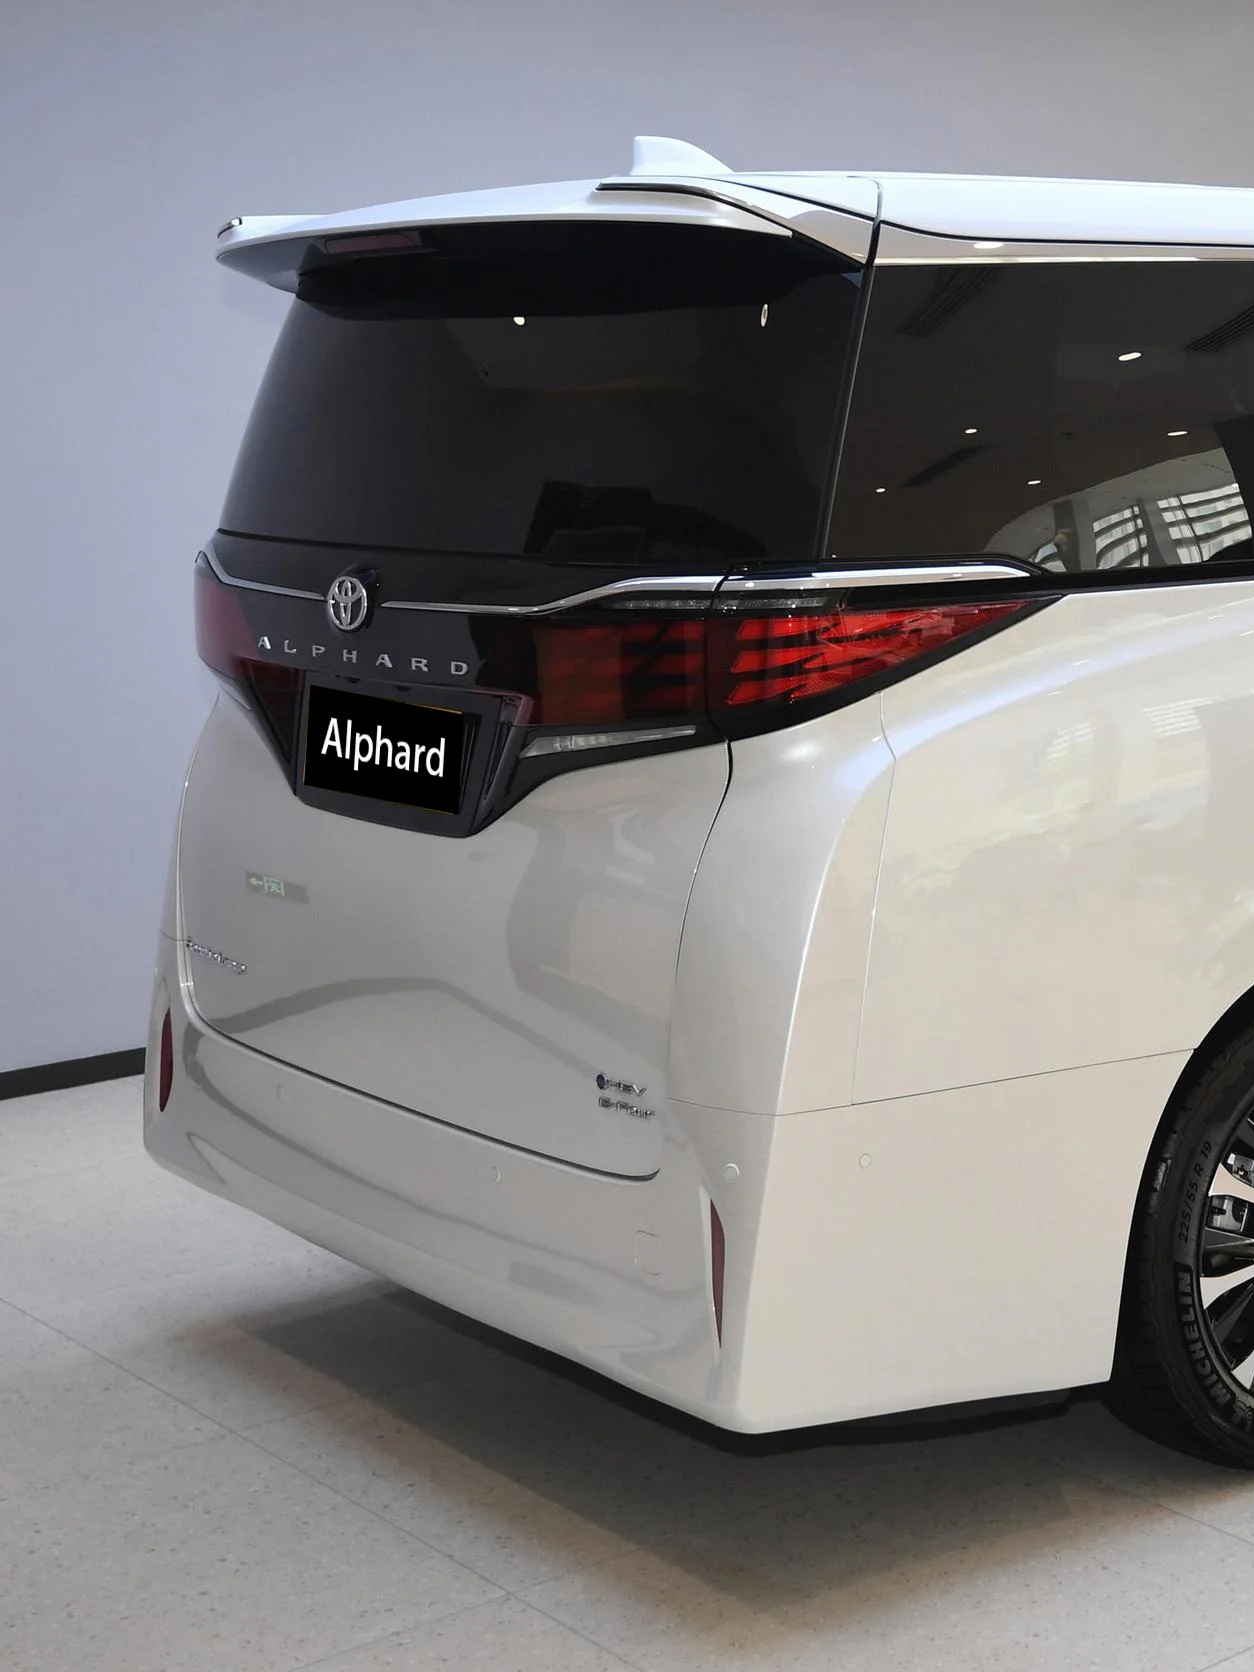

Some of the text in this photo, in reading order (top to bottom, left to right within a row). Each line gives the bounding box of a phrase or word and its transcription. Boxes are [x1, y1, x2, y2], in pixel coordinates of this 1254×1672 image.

[257, 636, 470, 676] ALPHARD
[321, 717, 446, 778] Alphard
[1178, 1140, 1213, 1244] 225/55 R 19
[1177, 1270, 1232, 1407] MICHELIN
